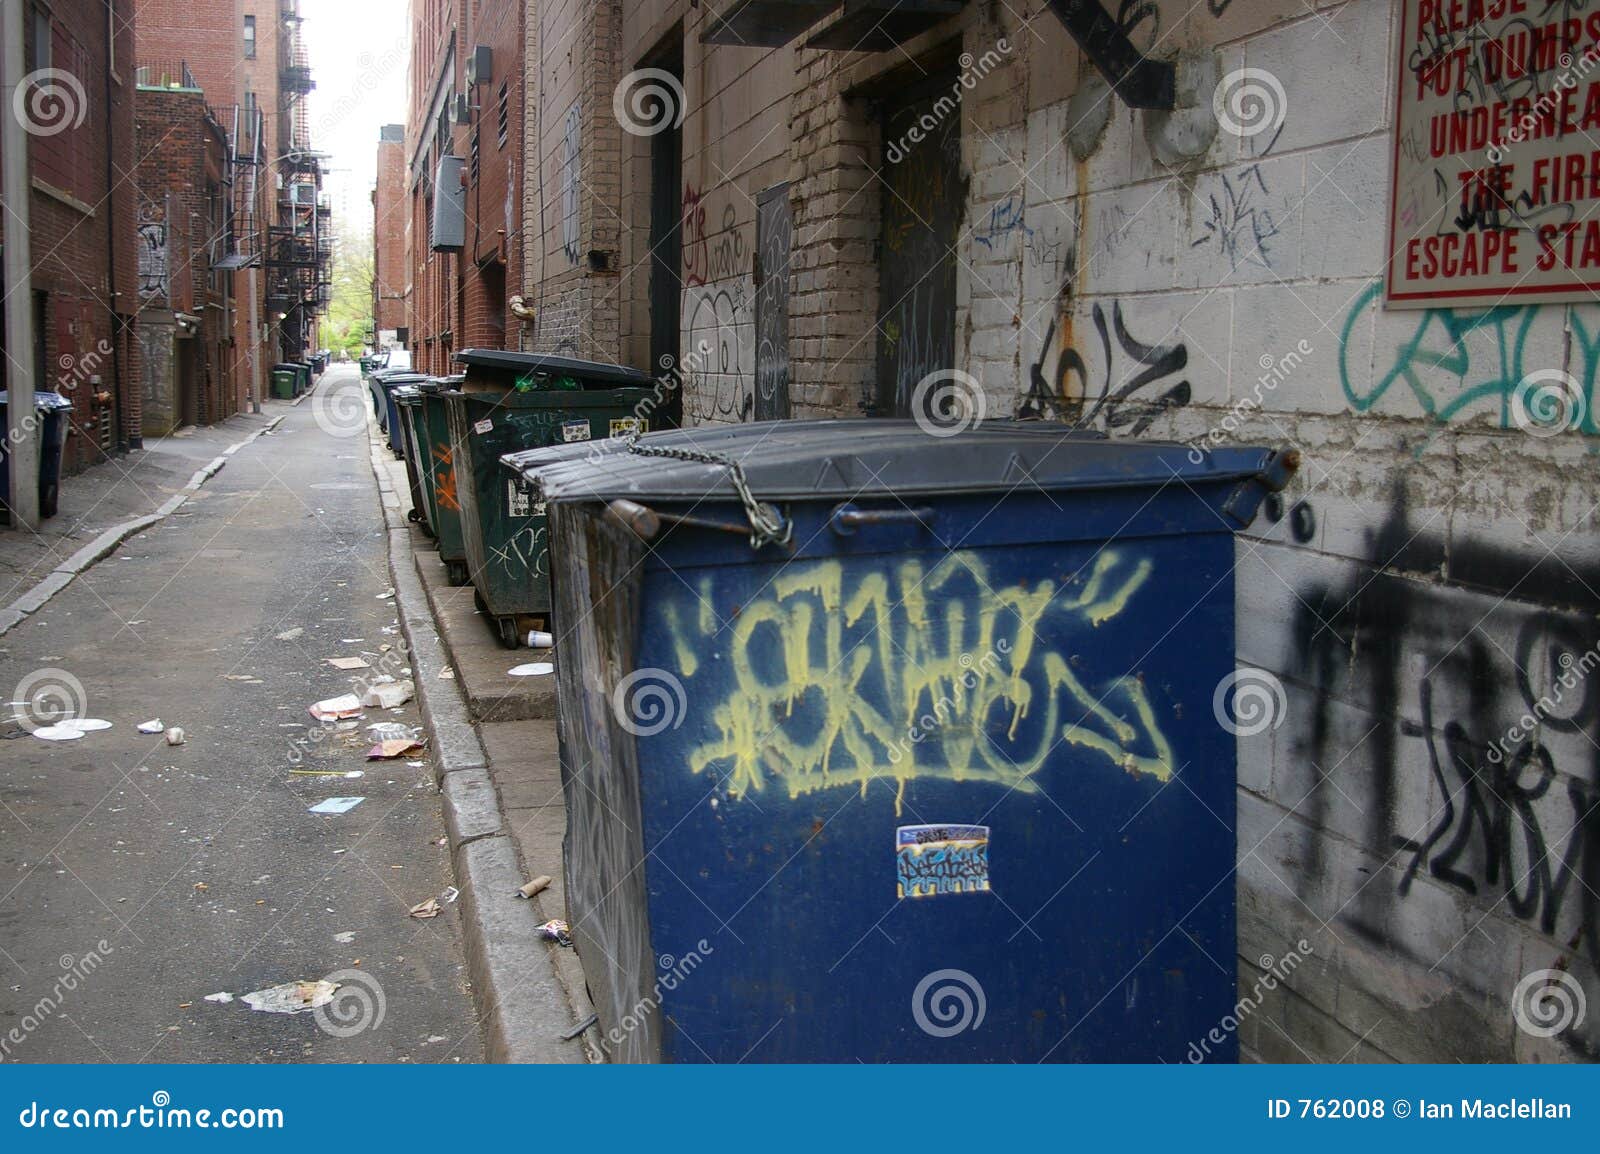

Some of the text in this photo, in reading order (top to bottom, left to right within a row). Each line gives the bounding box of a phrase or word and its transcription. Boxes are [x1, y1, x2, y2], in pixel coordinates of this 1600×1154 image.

[1417, 0, 1526, 42] PLEA
[1417, 47, 1470, 101] PUT
[1458, 163, 1514, 211] THE
[1406, 228, 1518, 280] ESCAPE
